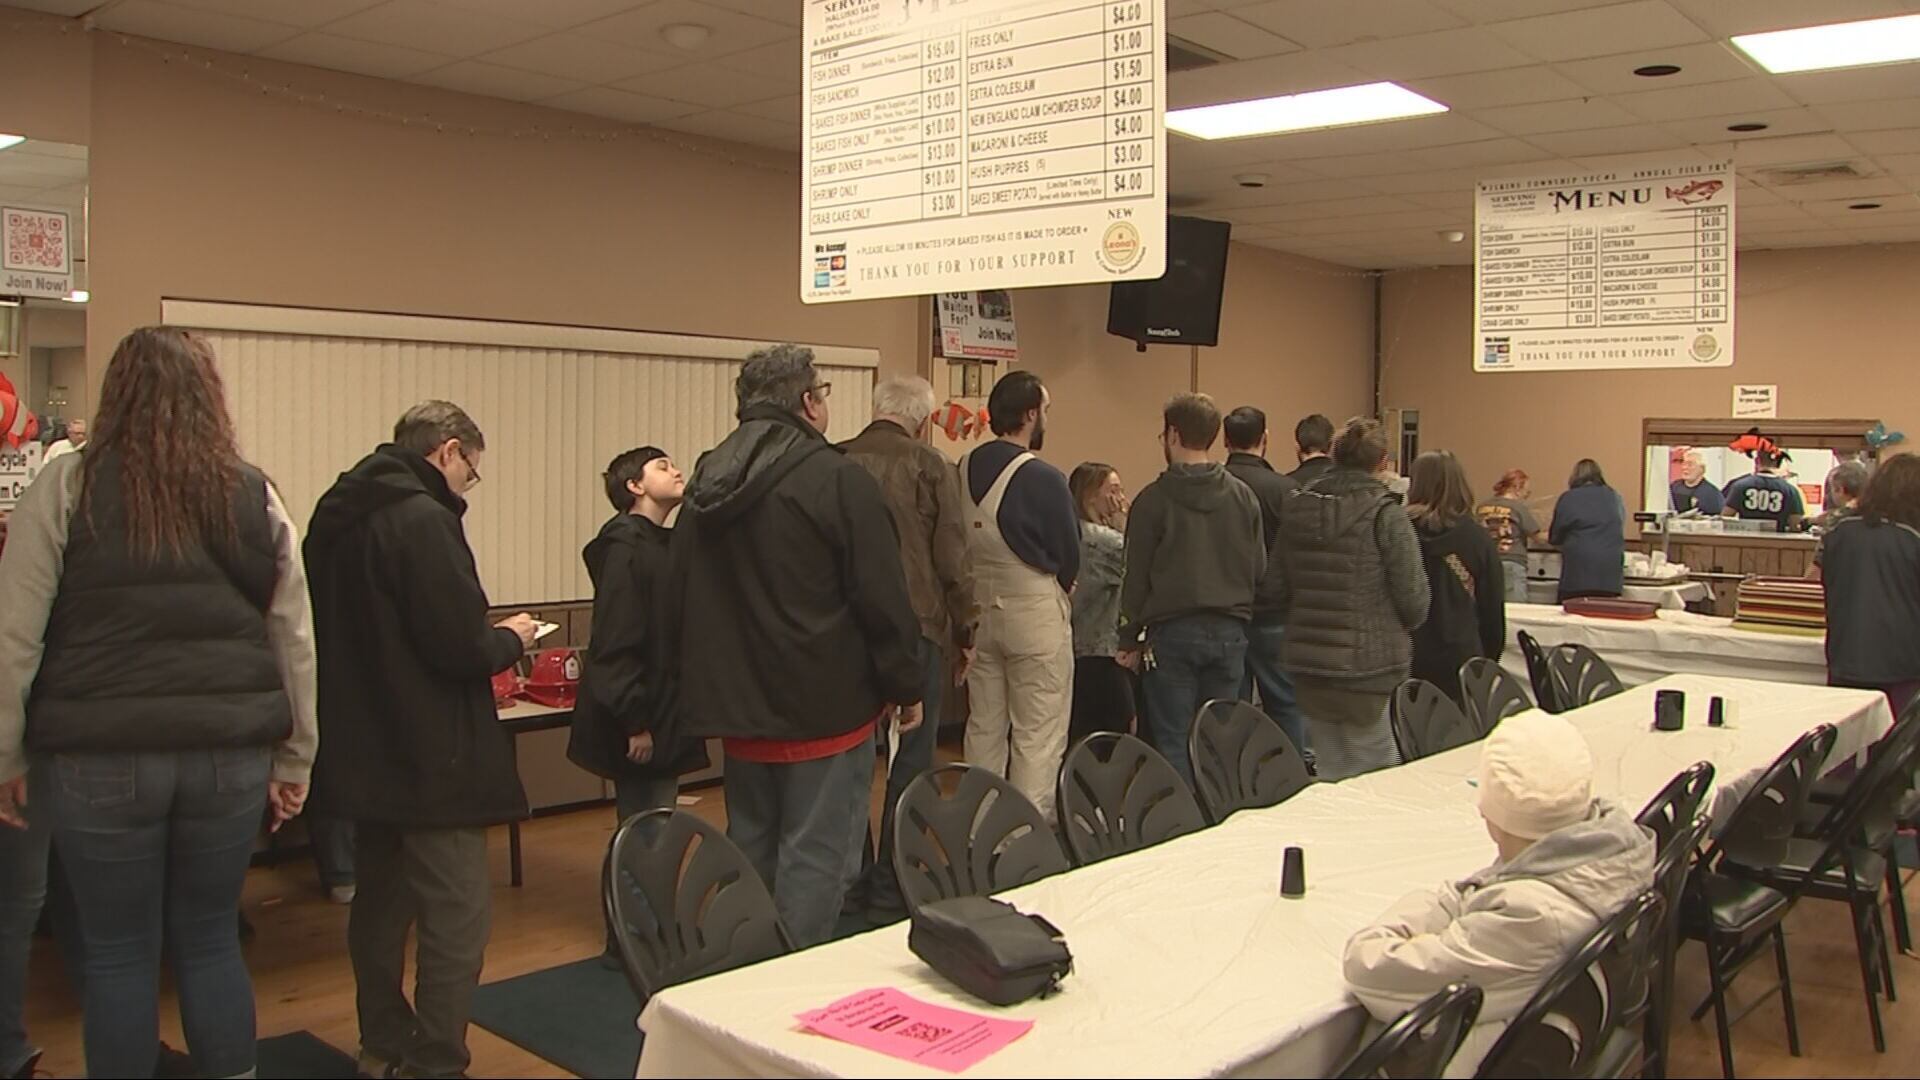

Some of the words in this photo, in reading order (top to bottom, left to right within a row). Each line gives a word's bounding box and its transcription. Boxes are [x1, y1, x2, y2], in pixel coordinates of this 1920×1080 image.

[1112, 3, 1142, 25] $4.00
[969, 33, 992, 49] FRIES
[993, 29, 1015, 45] ONLY
[1113, 31, 1142, 52] $1.00
[927, 39, 956, 60] $15.00
[927, 65, 956, 84] $12.00
[969, 60, 994, 75] EXTRA
[996, 56, 1014, 71] BUN
[1113, 59, 1142, 80] $1.50
[969, 85, 994, 101] EXTRA
[995, 79, 1036, 97] COLESLAW
[1113, 87, 1142, 108] $4.00
[927, 91, 956, 111] $13.00
[970, 113, 986, 127] NEW
[987, 107, 1019, 126] ENGLAND
[1020, 103, 1041, 121] CLAM
[1042, 99, 1079, 117] CHOWDER
[1080, 95, 1102, 111] SOUP
[925, 117, 956, 136] $10.00
[1113, 115, 1143, 136] $4.00
[927, 142, 956, 161] $13.00
[970, 137, 1009, 153] MACARONI
[1017, 130, 1049, 147] CHEESE
[1113, 143, 1142, 164] $3.00
[925, 168, 956, 187] $10.00
[970, 165, 992, 179] HUSH
[994, 159, 1030, 176] PUPPIES
[1113, 172, 1142, 193] $4.00
[932, 193, 956, 212] $3.00
[970, 192, 990, 206] BAKED
[991, 189, 1012, 203] SWEET
[1013, 186, 1038, 201] POTATO
[1490, 193, 1537, 203] SERVING
[1547, 187, 1652, 214] MENU
[1107, 207, 1134, 220] NEW
[861, 244, 883, 255] PLEASE
[885, 242, 905, 253] ALLOW
[915, 239, 941, 250] MINUTES
[942, 237, 956, 247] FOR
[957, 234, 980, 246] BAKED
[981, 233, 996, 243] FISH
[997, 232, 1006, 242] AS
[1015, 231, 1022, 240] IS
[1023, 228, 1043, 239] MADE
[1045, 227, 1055, 238] TO
[1056, 225, 1082, 237] ORDER
[860, 264, 899, 281] THANK
[906, 261, 930, 277] YOU
[937, 259, 961, 275] FOR
[969, 255, 1004, 272] YOUR
[1012, 249, 1075, 268] SUPPORT
[6, 274, 33, 289] Join
[36, 277, 67, 292] Now!
[943, 300, 974, 317] Waiting
[978, 326, 994, 340] Join
[1580, 350, 1597, 359] FOR
[1632, 347, 1676, 358] SUPPORT
[1744, 487, 1783, 513] 303
